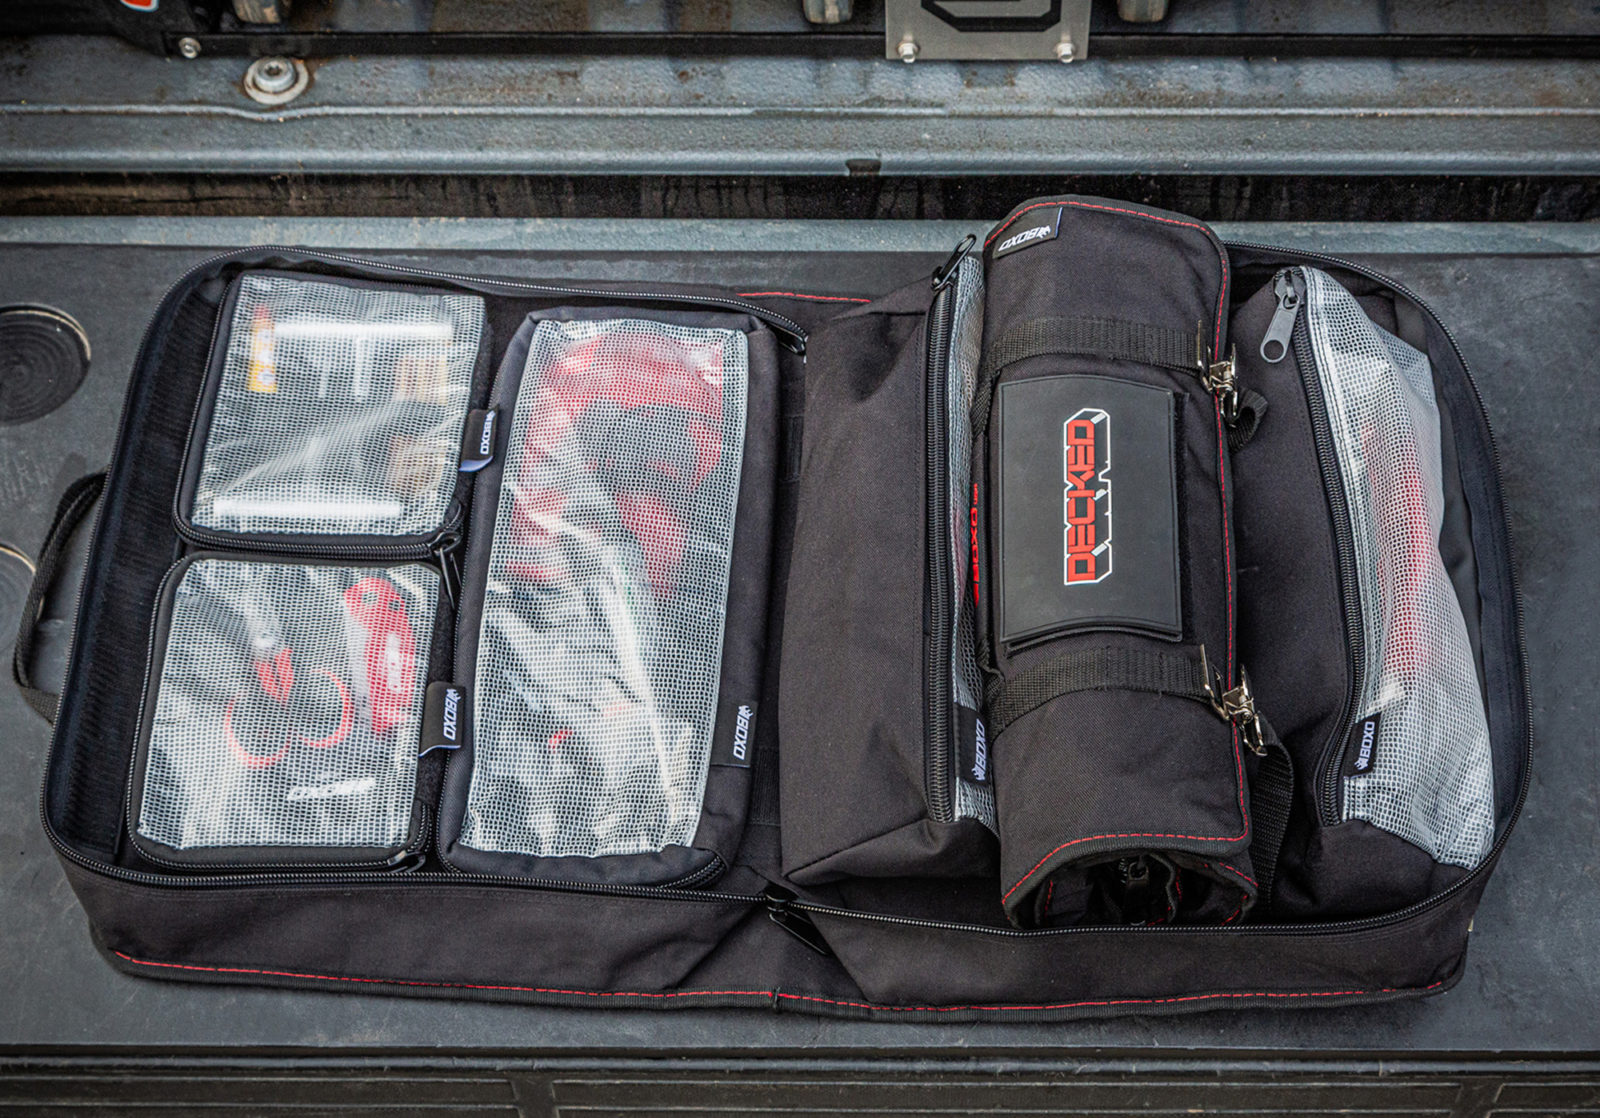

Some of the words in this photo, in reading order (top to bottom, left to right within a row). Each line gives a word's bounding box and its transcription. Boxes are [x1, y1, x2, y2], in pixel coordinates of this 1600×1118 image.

[998, 226, 1040, 252] BOXO
[480, 421, 492, 455] BOXO
[1065, 414, 1101, 584] DECKED
[443, 697, 458, 741] BOXO
[733, 715, 749, 761] BOXO
[1360, 721, 1375, 759] BOXO
[976, 718, 986, 772] BOXO
